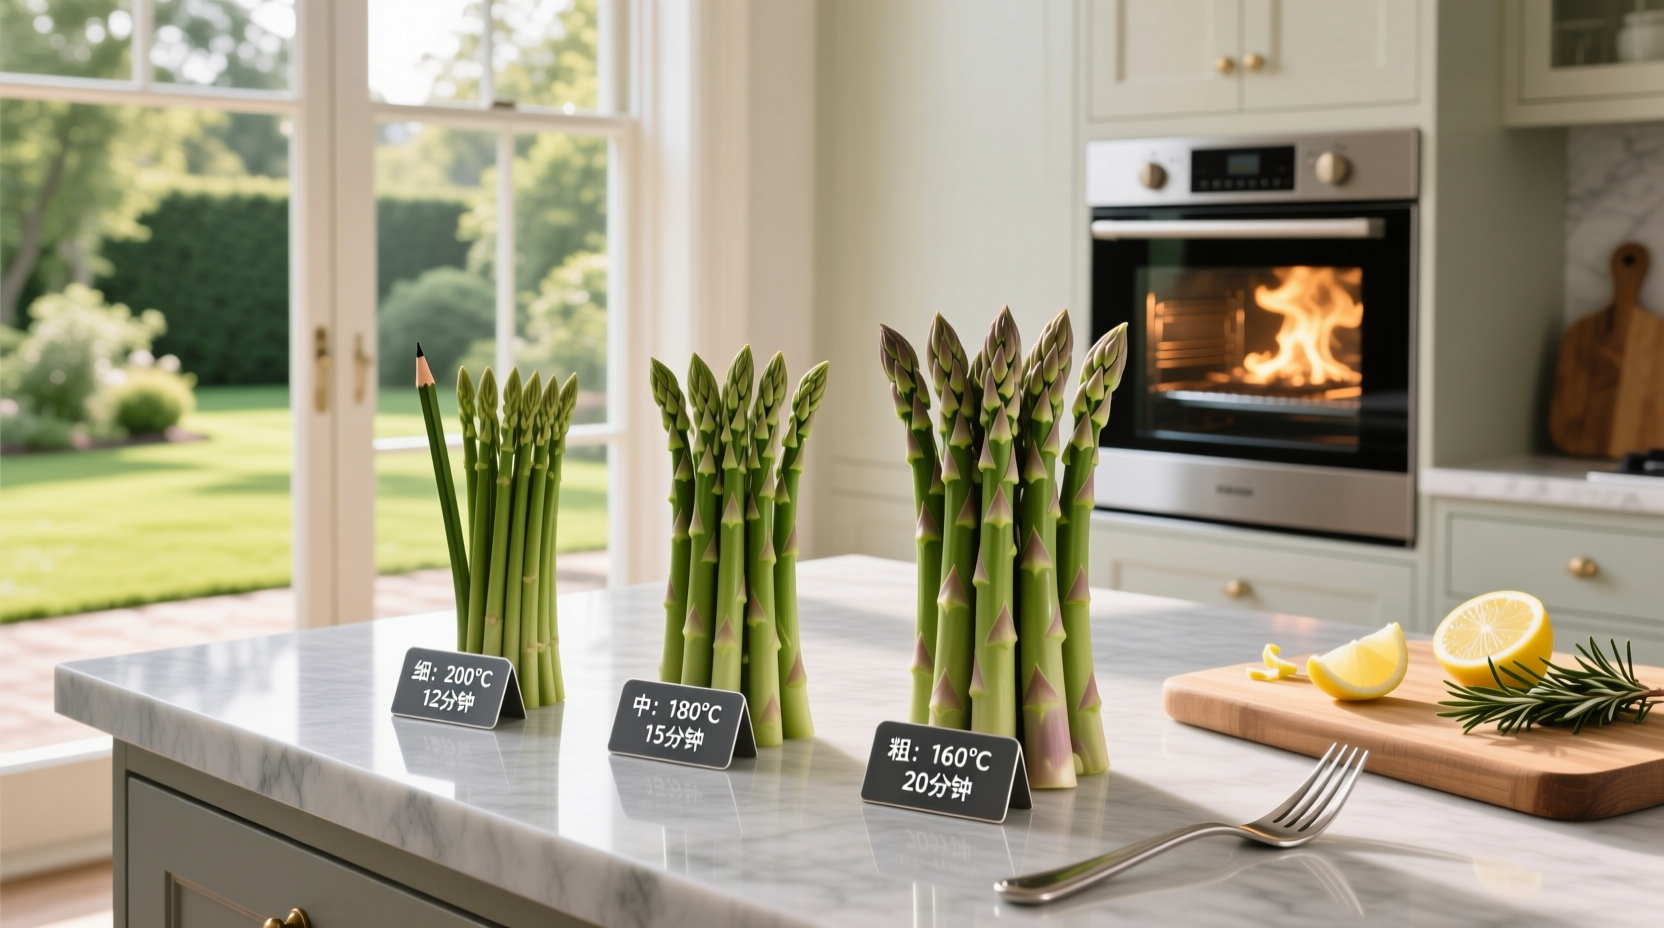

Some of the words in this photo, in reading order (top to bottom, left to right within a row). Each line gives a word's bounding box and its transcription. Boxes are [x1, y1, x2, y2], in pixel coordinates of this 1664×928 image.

[423, 689, 475, 713] 12分钟
[645, 724, 704, 752] 15分钟
[901, 770, 973, 802] 20分钟
